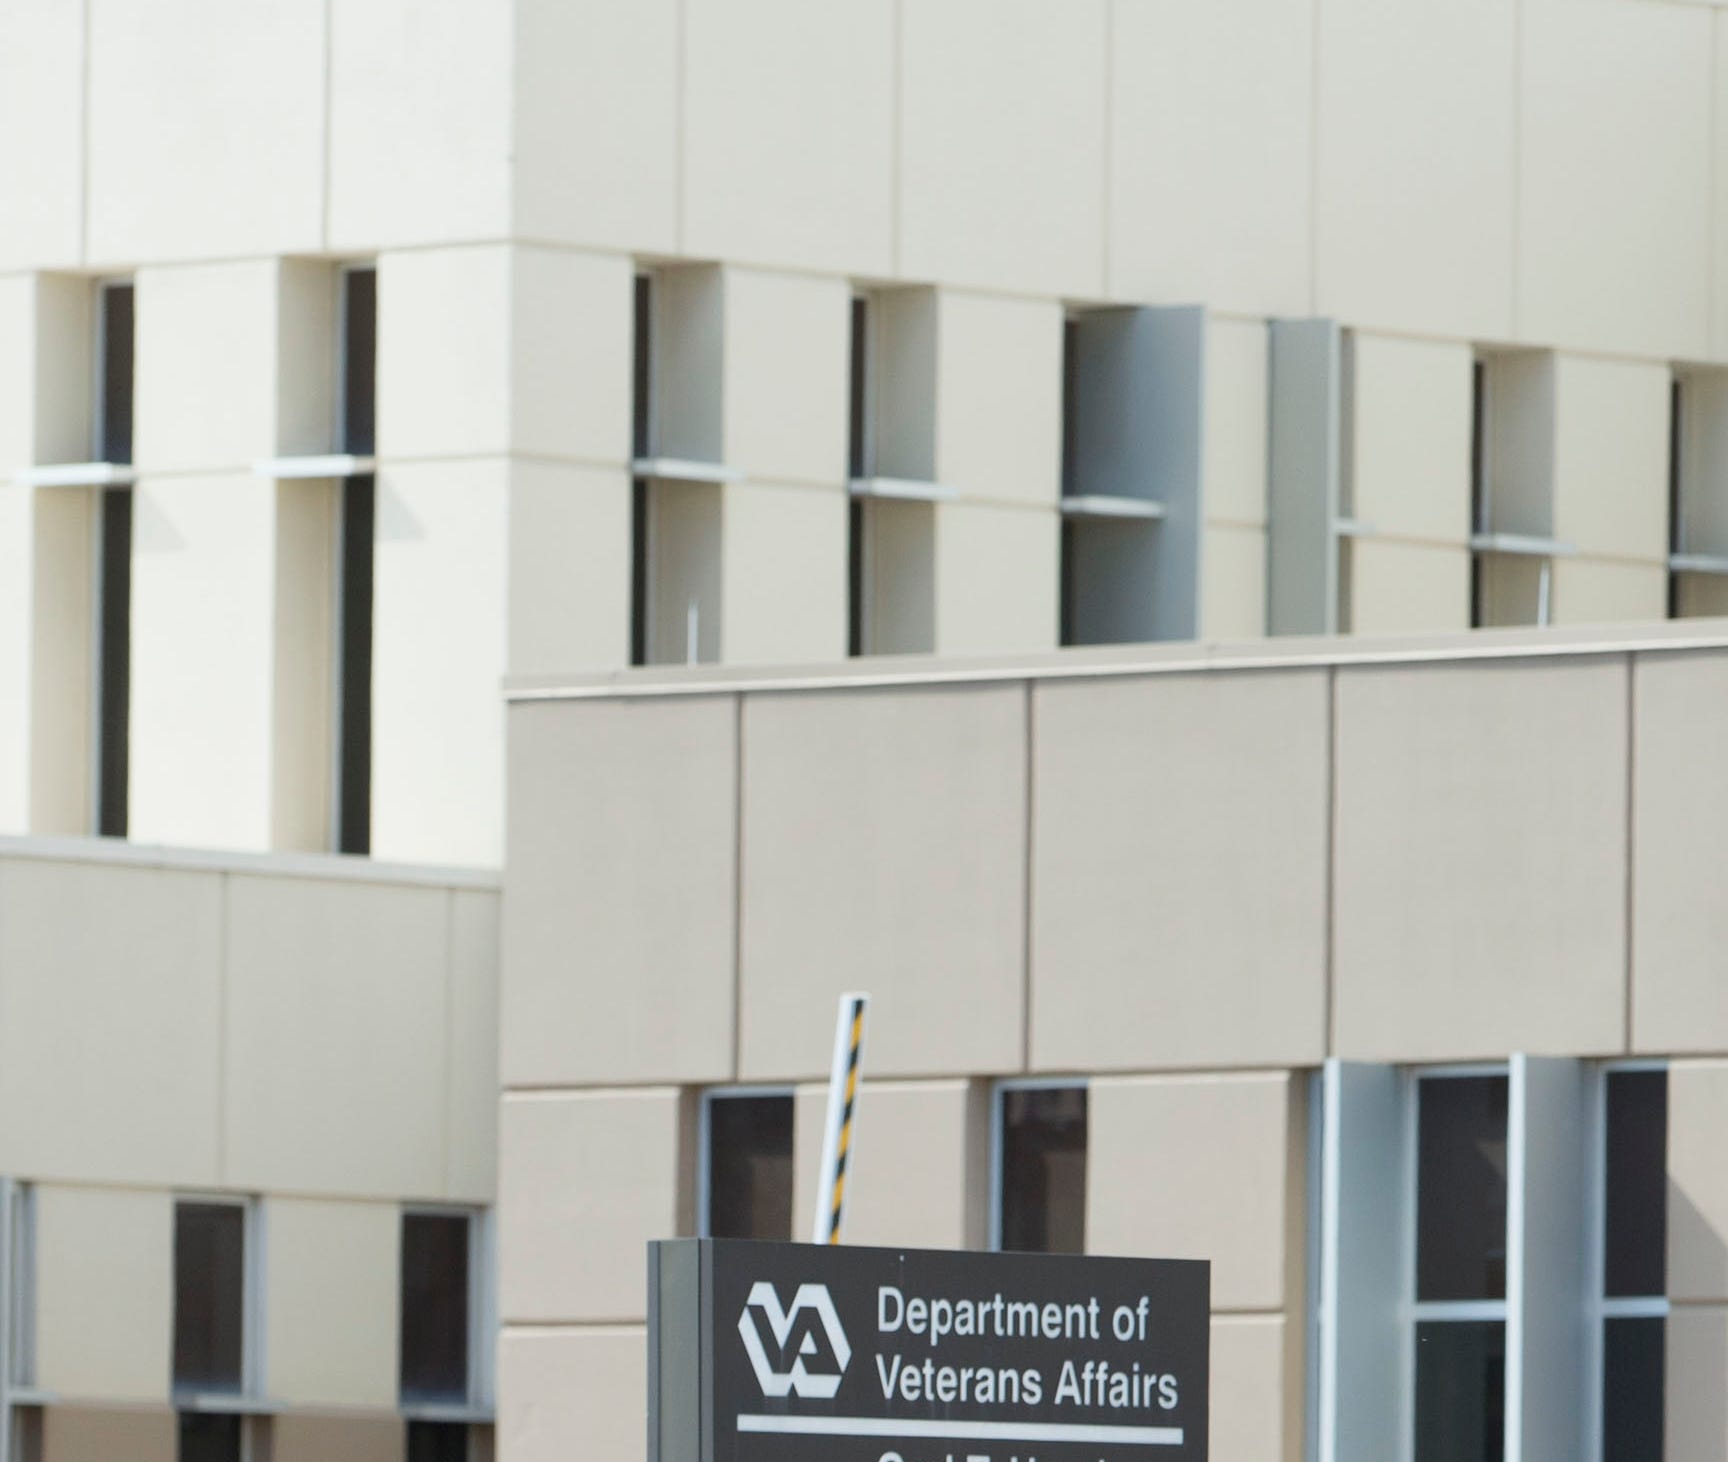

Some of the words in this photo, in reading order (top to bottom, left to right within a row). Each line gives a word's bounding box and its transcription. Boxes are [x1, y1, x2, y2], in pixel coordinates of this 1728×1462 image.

[877, 1285, 1100, 1346] Department
[1112, 1295, 1149, 1341] of
[875, 1353, 1042, 1405] Veterans
[1054, 1359, 1178, 1410] Affairs
